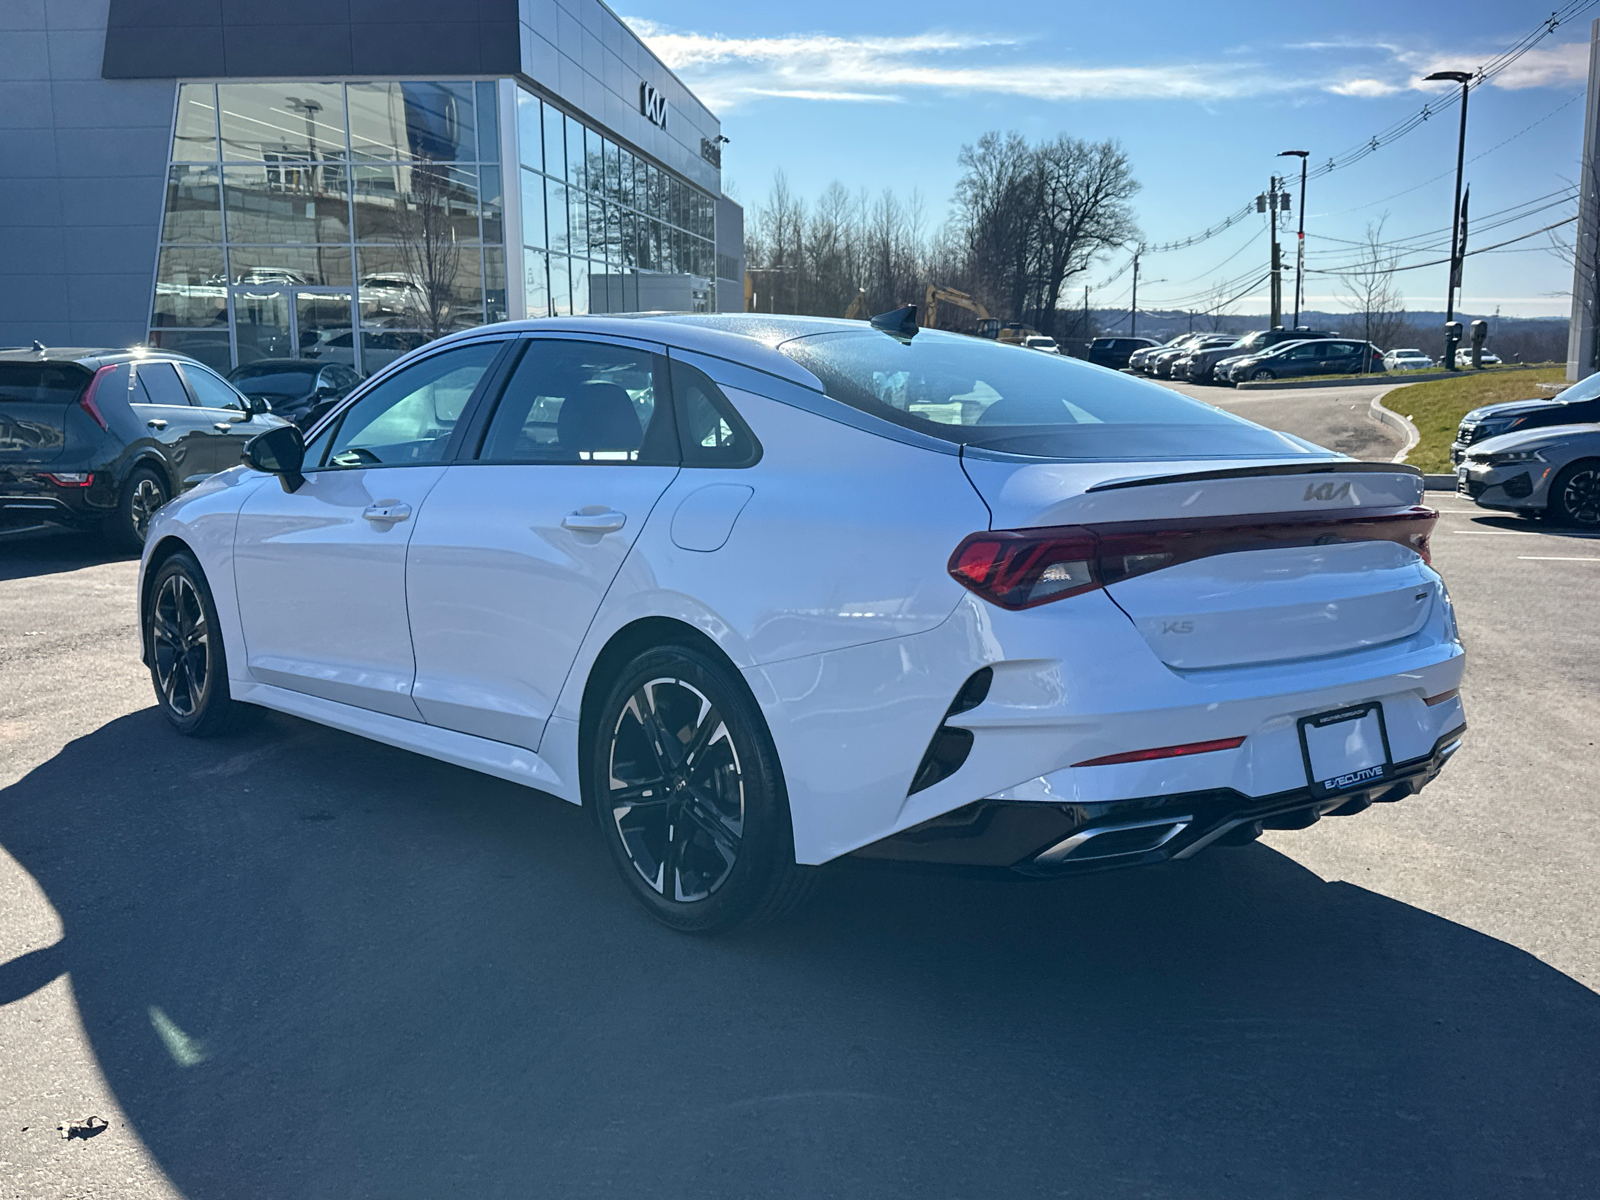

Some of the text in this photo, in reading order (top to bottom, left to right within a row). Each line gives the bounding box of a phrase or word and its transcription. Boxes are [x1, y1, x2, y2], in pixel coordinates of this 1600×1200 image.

[640, 81, 668, 131] KIA
[1303, 481, 1351, 501] KIA
[1161, 621, 1194, 635] K5
[1324, 766, 1383, 790] EXECUTIVE
